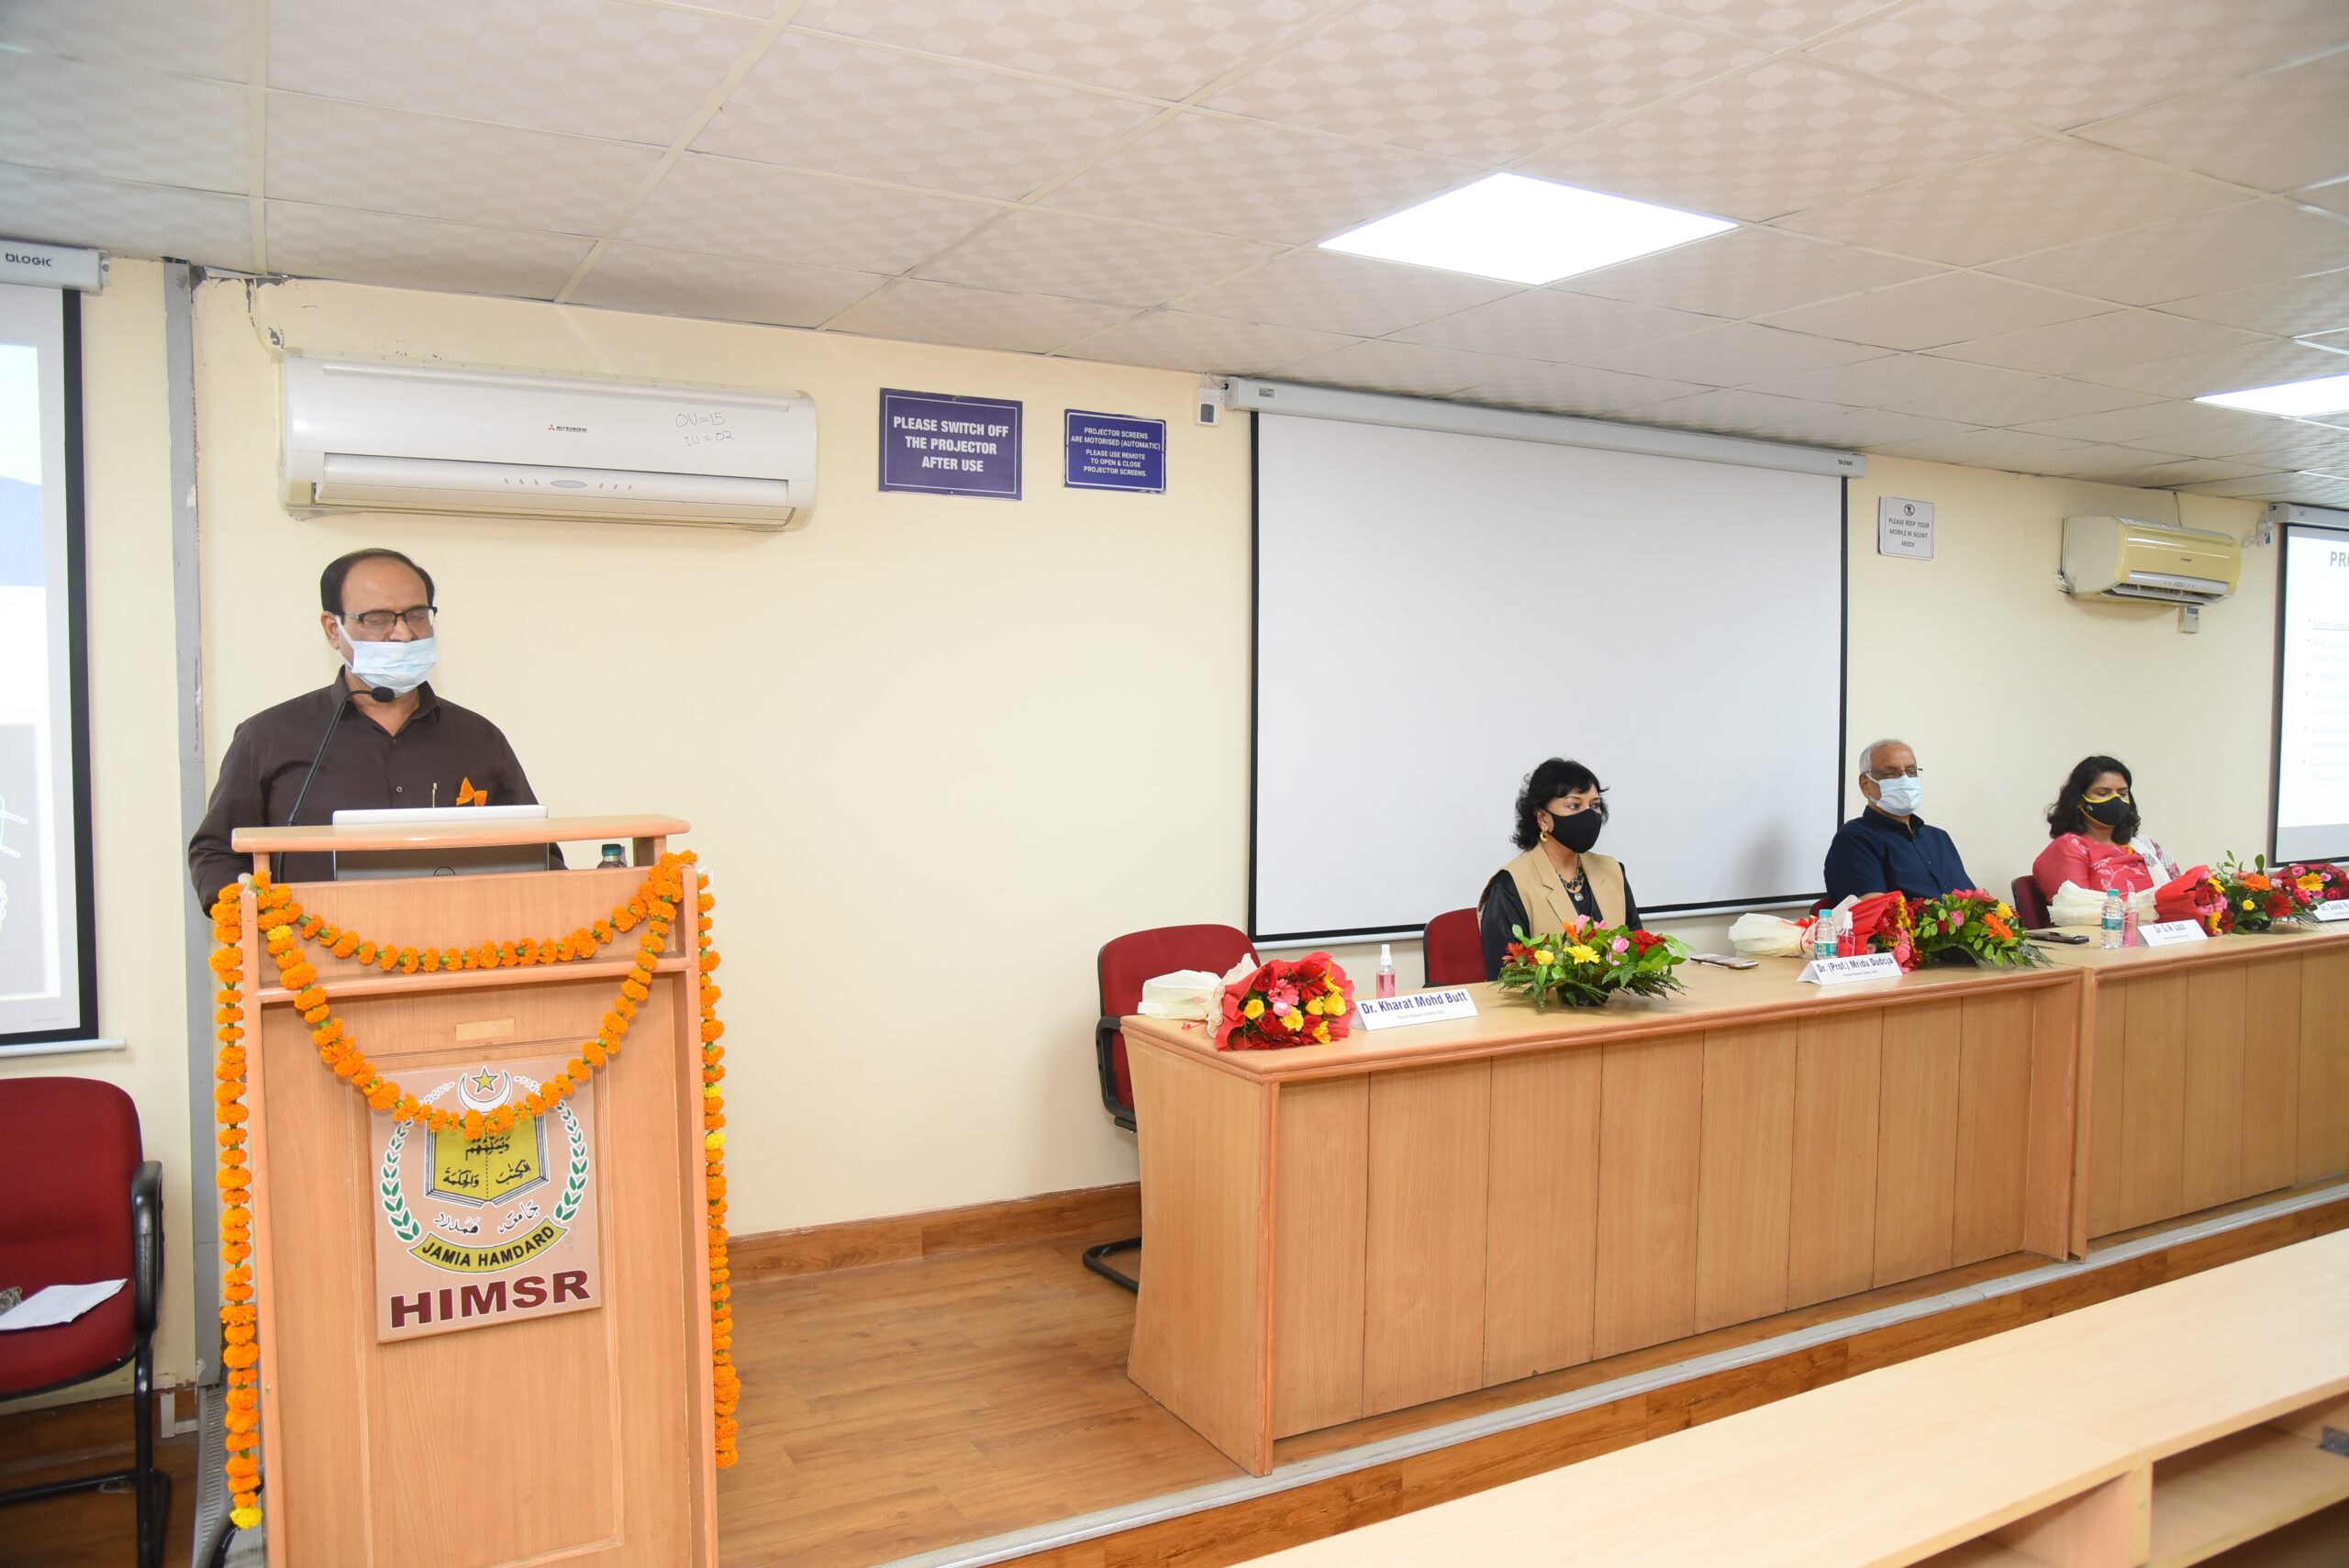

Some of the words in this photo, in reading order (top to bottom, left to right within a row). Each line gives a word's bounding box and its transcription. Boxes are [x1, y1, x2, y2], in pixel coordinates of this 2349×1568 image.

[893, 416, 938, 431] PLEASE
[941, 420, 985, 436] SWITCH
[987, 425, 1009, 438] OFF
[1084, 428, 1119, 437] PROJECTOR
[1120, 430, 1149, 439] SCREENS
[905, 436, 927, 449] THE
[930, 438, 997, 455] PROJECTOR
[1084, 437, 1119, 446] MOTORISED
[1120, 440, 1161, 450] (AUTOMATIC)
[1085, 449, 1108, 457] PLEASE
[1121, 452, 1146, 461] REMOTE
[921, 456, 958, 470] AFTER
[961, 459, 984, 473] USE
[1084, 465, 1119, 474] PROJECTOR
[1888, 517, 1905, 526] PLEASE
[1917, 521, 1930, 529] YOUR
[1889, 528, 1907, 537] MOBILE
[1912, 531, 1928, 539] SILENT
[2330, 550, 2349, 568] PR
[1361, 1003, 1377, 1014] Dr.
[1378, 997, 1414, 1011] Kharat
[1414, 994, 1444, 1007] Mohd
[1444, 991, 1468, 1004] Butt
[421, 1242, 472, 1268] JAMIA
[477, 1226, 555, 1267] HAMDARD
[390, 1269, 593, 1329] HIMSR
